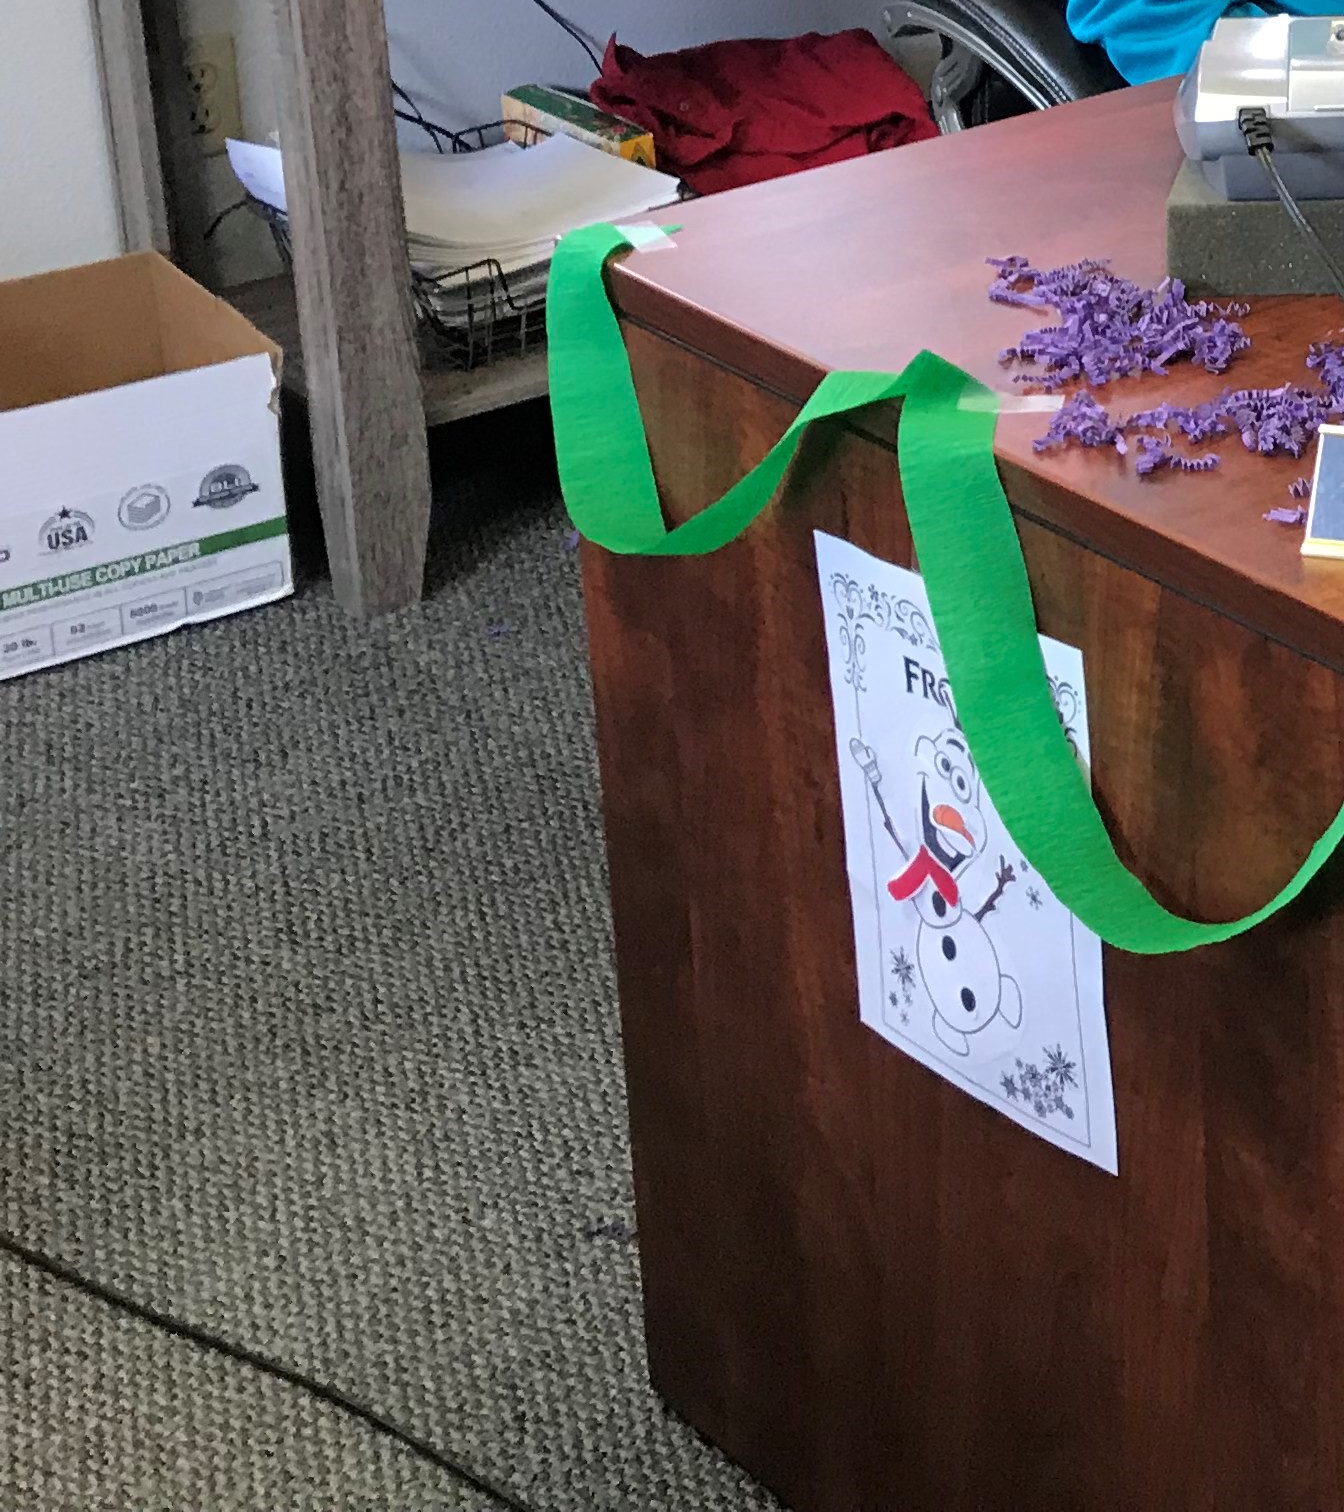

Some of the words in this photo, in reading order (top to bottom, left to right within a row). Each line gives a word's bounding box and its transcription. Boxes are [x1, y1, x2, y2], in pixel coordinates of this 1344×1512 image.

[47, 526, 89, 550] USA
[96, 555, 144, 586] COPY
[145, 542, 201, 572] PAPER
